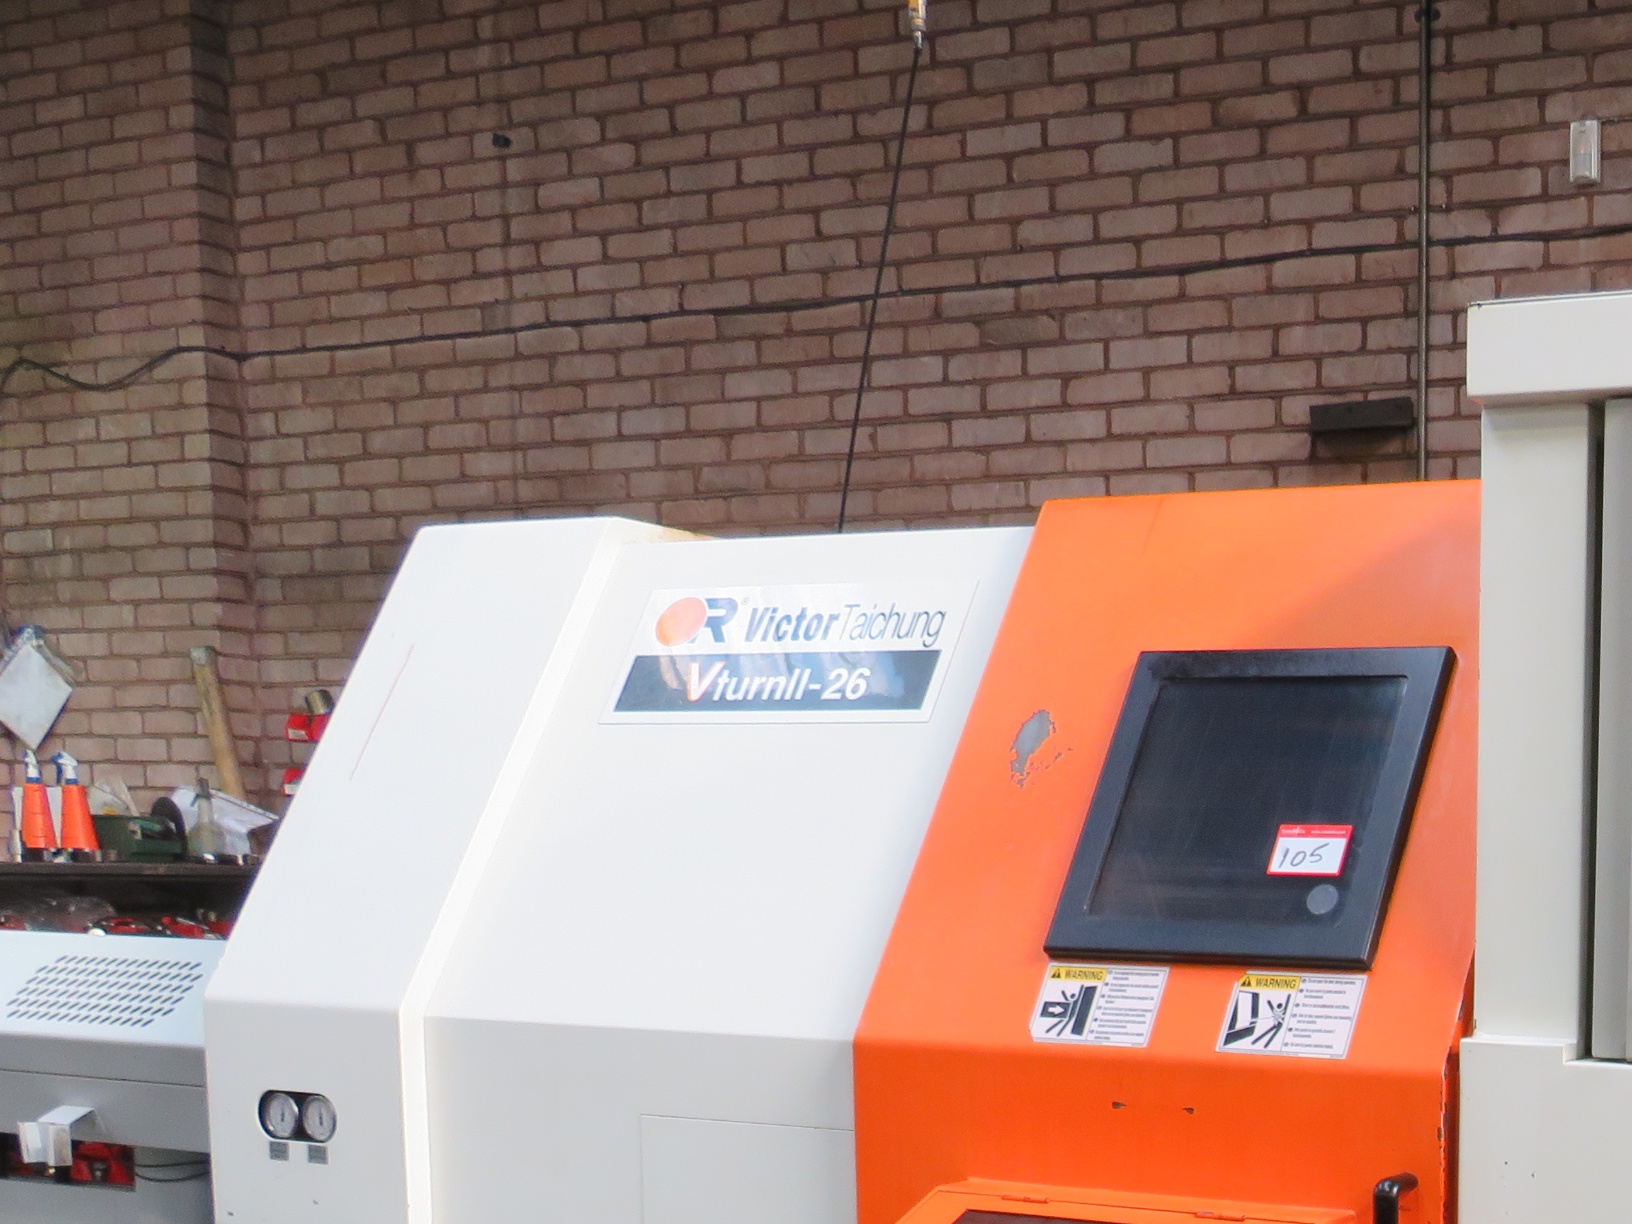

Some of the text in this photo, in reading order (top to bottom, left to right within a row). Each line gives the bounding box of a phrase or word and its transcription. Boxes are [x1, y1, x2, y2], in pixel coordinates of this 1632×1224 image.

[1279, 842, 1330, 868] 105
[1065, 968, 1104, 981] WARNING
[1255, 977, 1297, 990] WARNING
